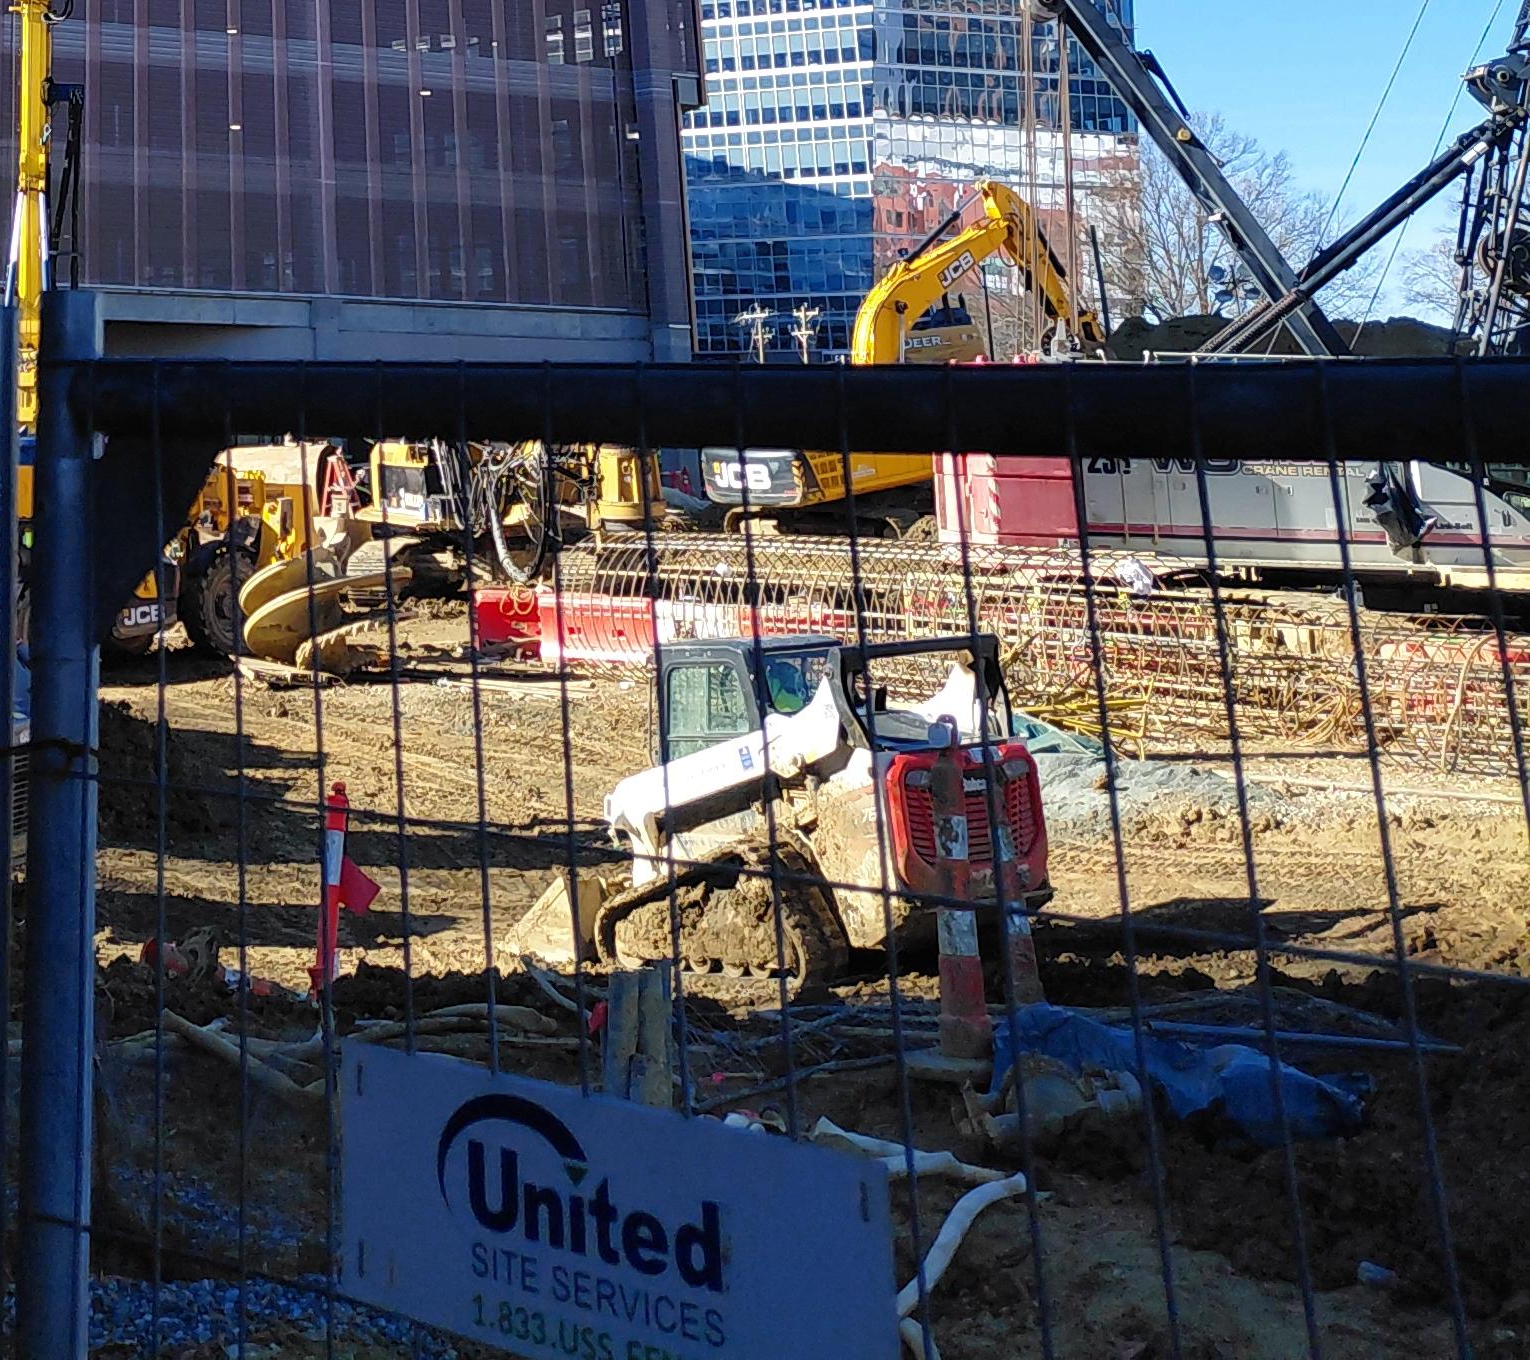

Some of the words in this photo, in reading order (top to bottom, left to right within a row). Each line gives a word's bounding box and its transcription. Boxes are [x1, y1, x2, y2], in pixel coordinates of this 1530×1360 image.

[939, 251, 975, 287] JCB
[712, 461, 772, 490] JCB
[1241, 465, 1299, 477] CRANE
[1302, 466, 1366, 478] RENTAL
[466, 1138, 724, 1294] United
[470, 1241, 540, 1295] SITE
[551, 1264, 726, 1348] SERVICES
